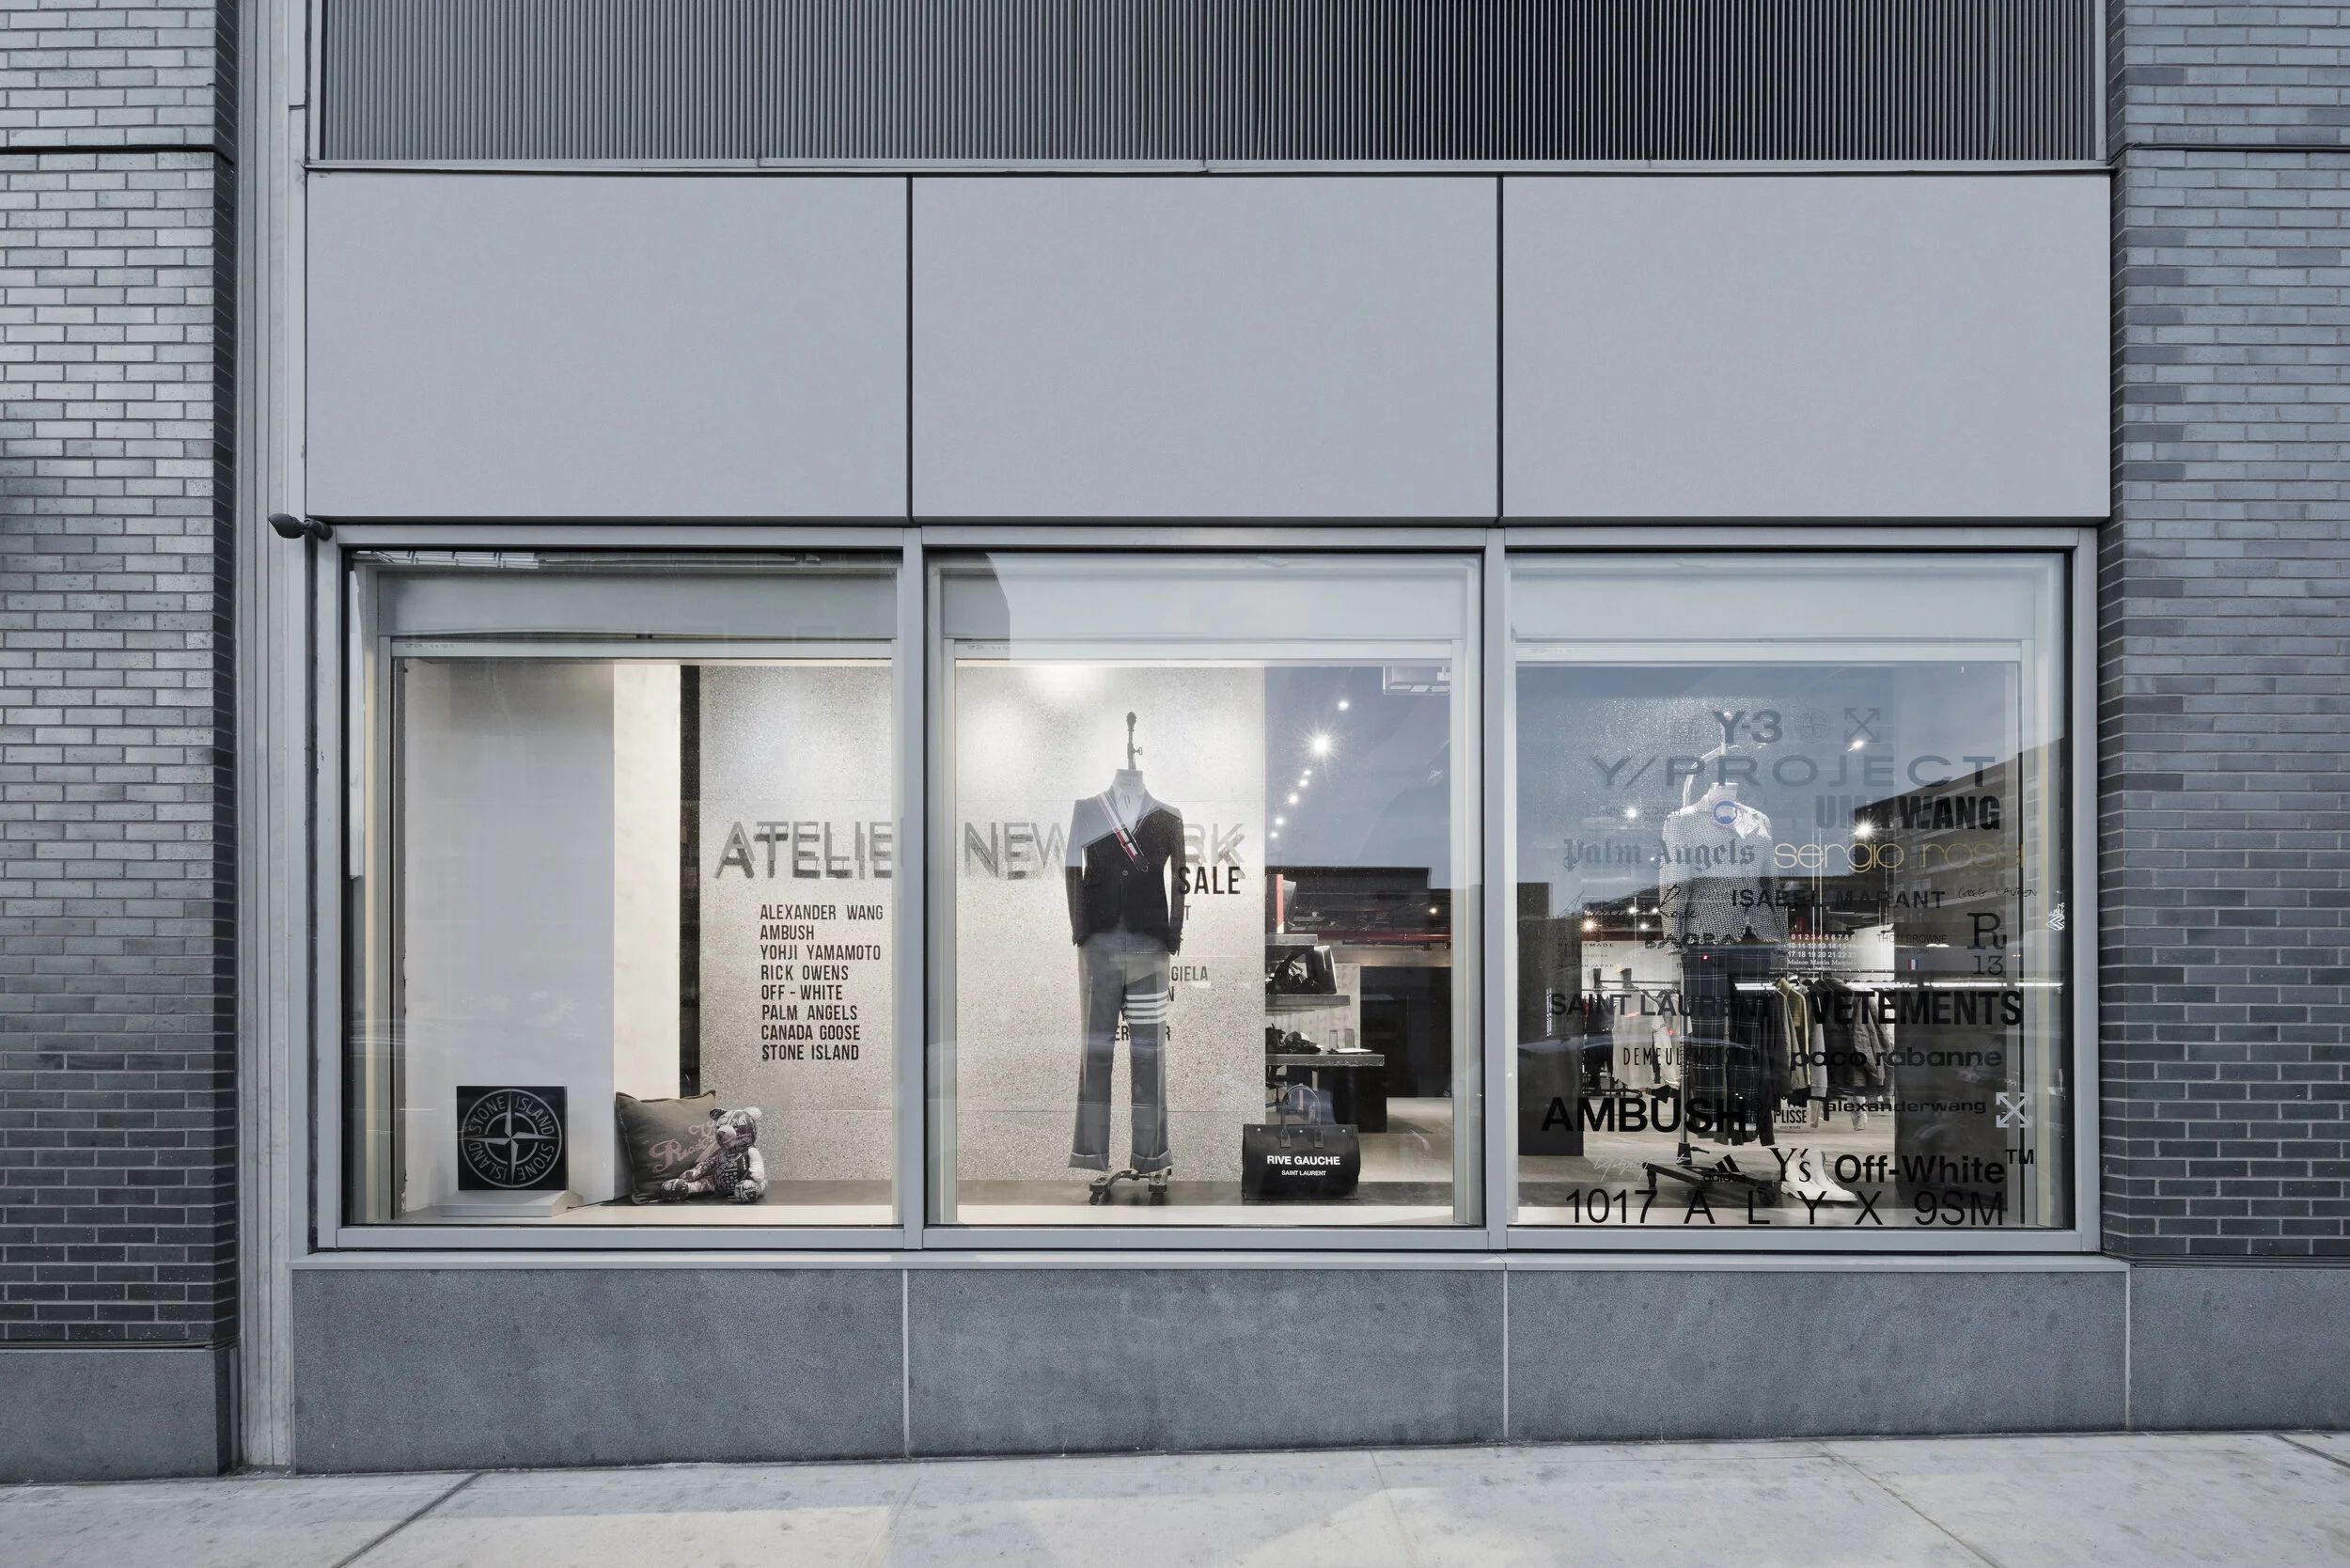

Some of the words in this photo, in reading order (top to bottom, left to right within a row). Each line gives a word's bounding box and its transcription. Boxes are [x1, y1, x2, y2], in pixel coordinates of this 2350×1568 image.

[1712, 709, 1783, 744] Y-3
[1589, 755, 1996, 788] Y/PROJECT
[1898, 795, 2000, 830] WANG
[1652, 839, 1755, 871] Angels
[1774, 842, 1904, 873] sergio
[1922, 842, 2024, 869] rossi
[1178, 866, 1241, 895] SALE
[1836, 890, 1946, 909] MARANT
[760, 904, 837, 920] ALEXANDER
[846, 904, 884, 920] WANG
[760, 925, 815, 941] AMBUSH
[1876, 933, 1904, 943] THOM
[760, 945, 798, 961] YOHJI
[807, 945, 882, 961] YAMAMOTO
[760, 964, 793, 980] RICK
[802, 964, 849, 980] OWENS
[1972, 955, 2004, 976] 13
[761, 1005, 798, 1021] PALM
[807, 1005, 857, 1021] ANGELS
[1551, 994, 1632, 1016] SAINT
[1810, 990, 2022, 1026] VETEMENTS
[761, 1025, 813, 1041] CANADA
[820, 1025, 860, 1041] GOOSE
[761, 1044, 805, 1060] STONE
[811, 1044, 859, 1060] ISLAND
[1790, 1050, 1867, 1071] paco
[1876, 1046, 2002, 1067] rabanne
[468, 1095, 506, 1134] STONE
[515, 1096, 555, 1136] ISLAND
[1827, 1100, 1986, 1115] alexanderwang
[1266, 1155, 1292, 1165] RIVE
[1293, 1155, 1341, 1166] GAUCHE
[1565, 1188, 1657, 1224] 1017
[1914, 1190, 2004, 1226] 9SM
